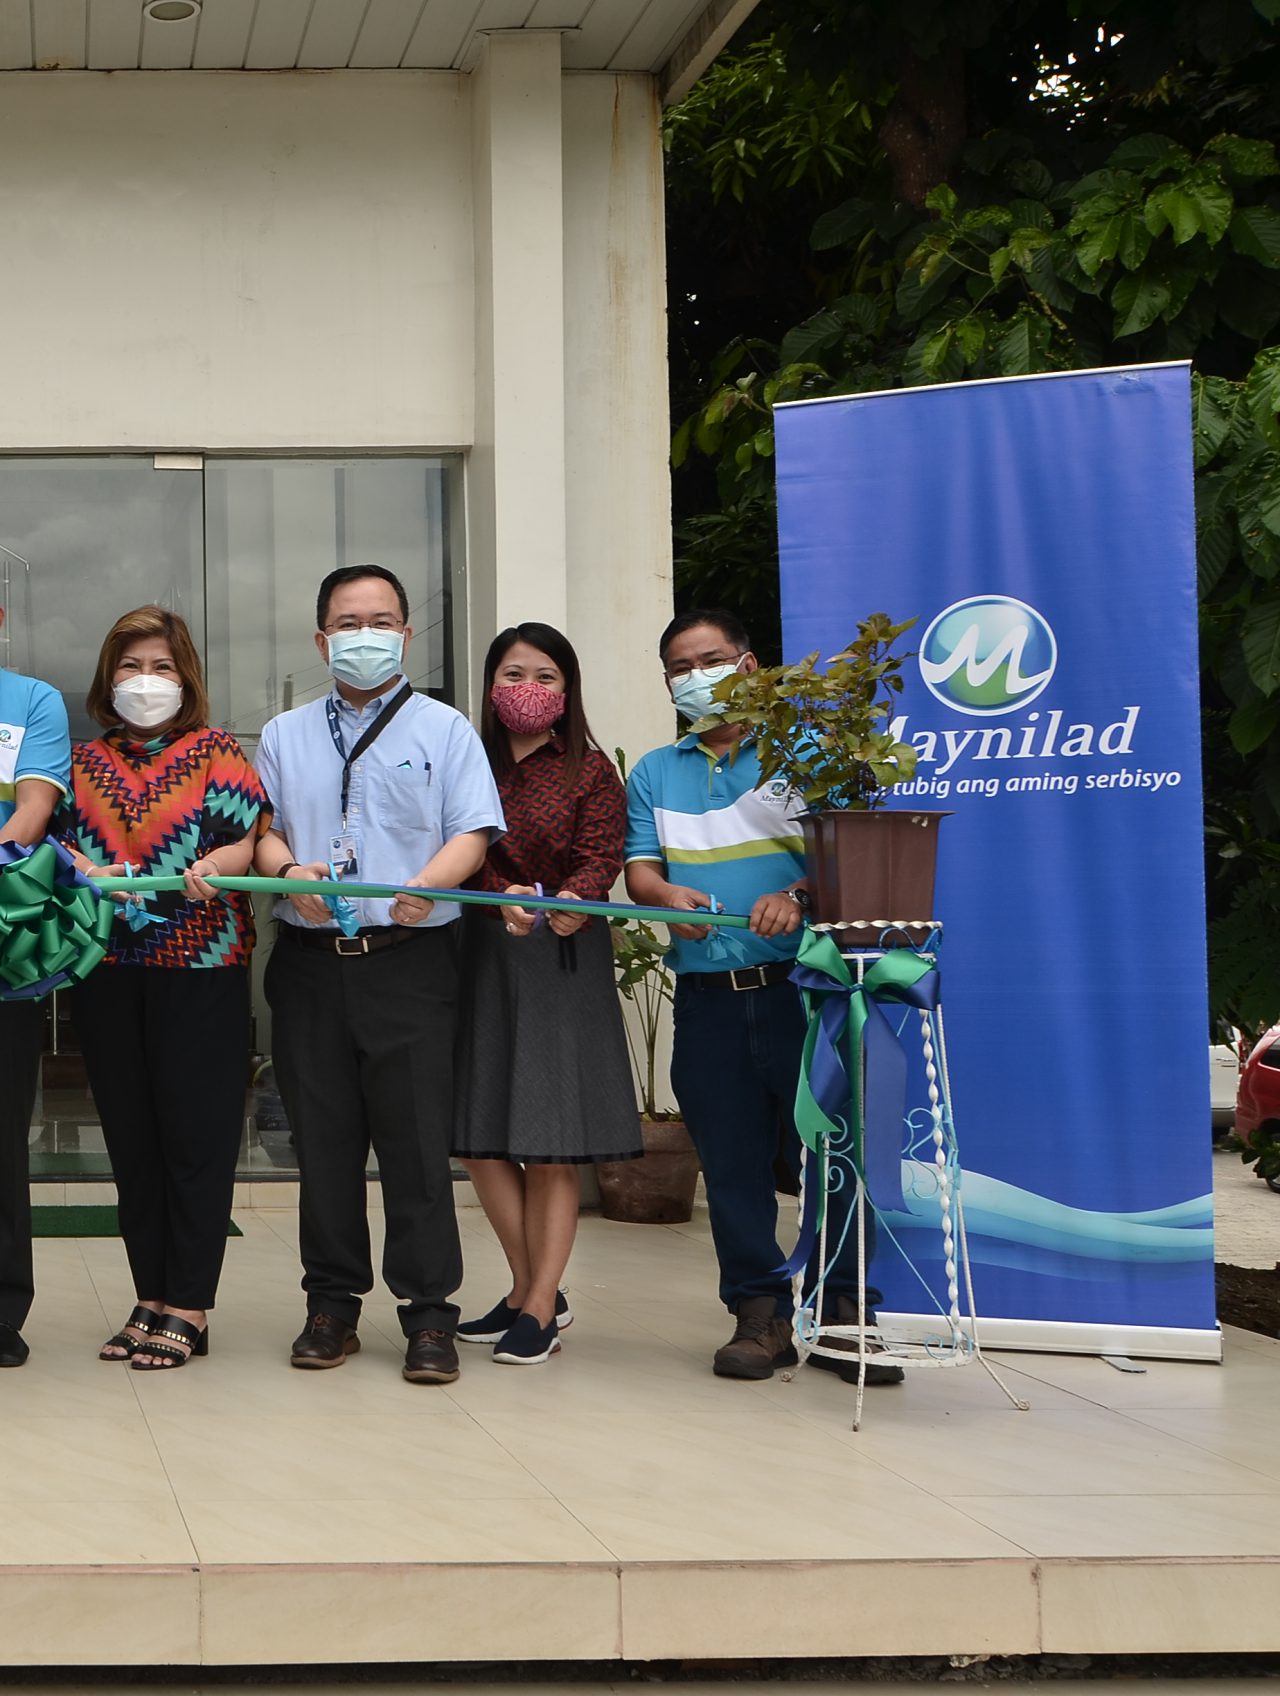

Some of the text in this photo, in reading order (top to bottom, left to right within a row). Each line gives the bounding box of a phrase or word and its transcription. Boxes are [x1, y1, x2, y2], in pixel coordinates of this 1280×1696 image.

[893, 776, 951, 799] tubig
[956, 779, 1000, 798] ang
[1005, 772, 1079, 795] aming
[1084, 767, 1181, 792] serbisyo
